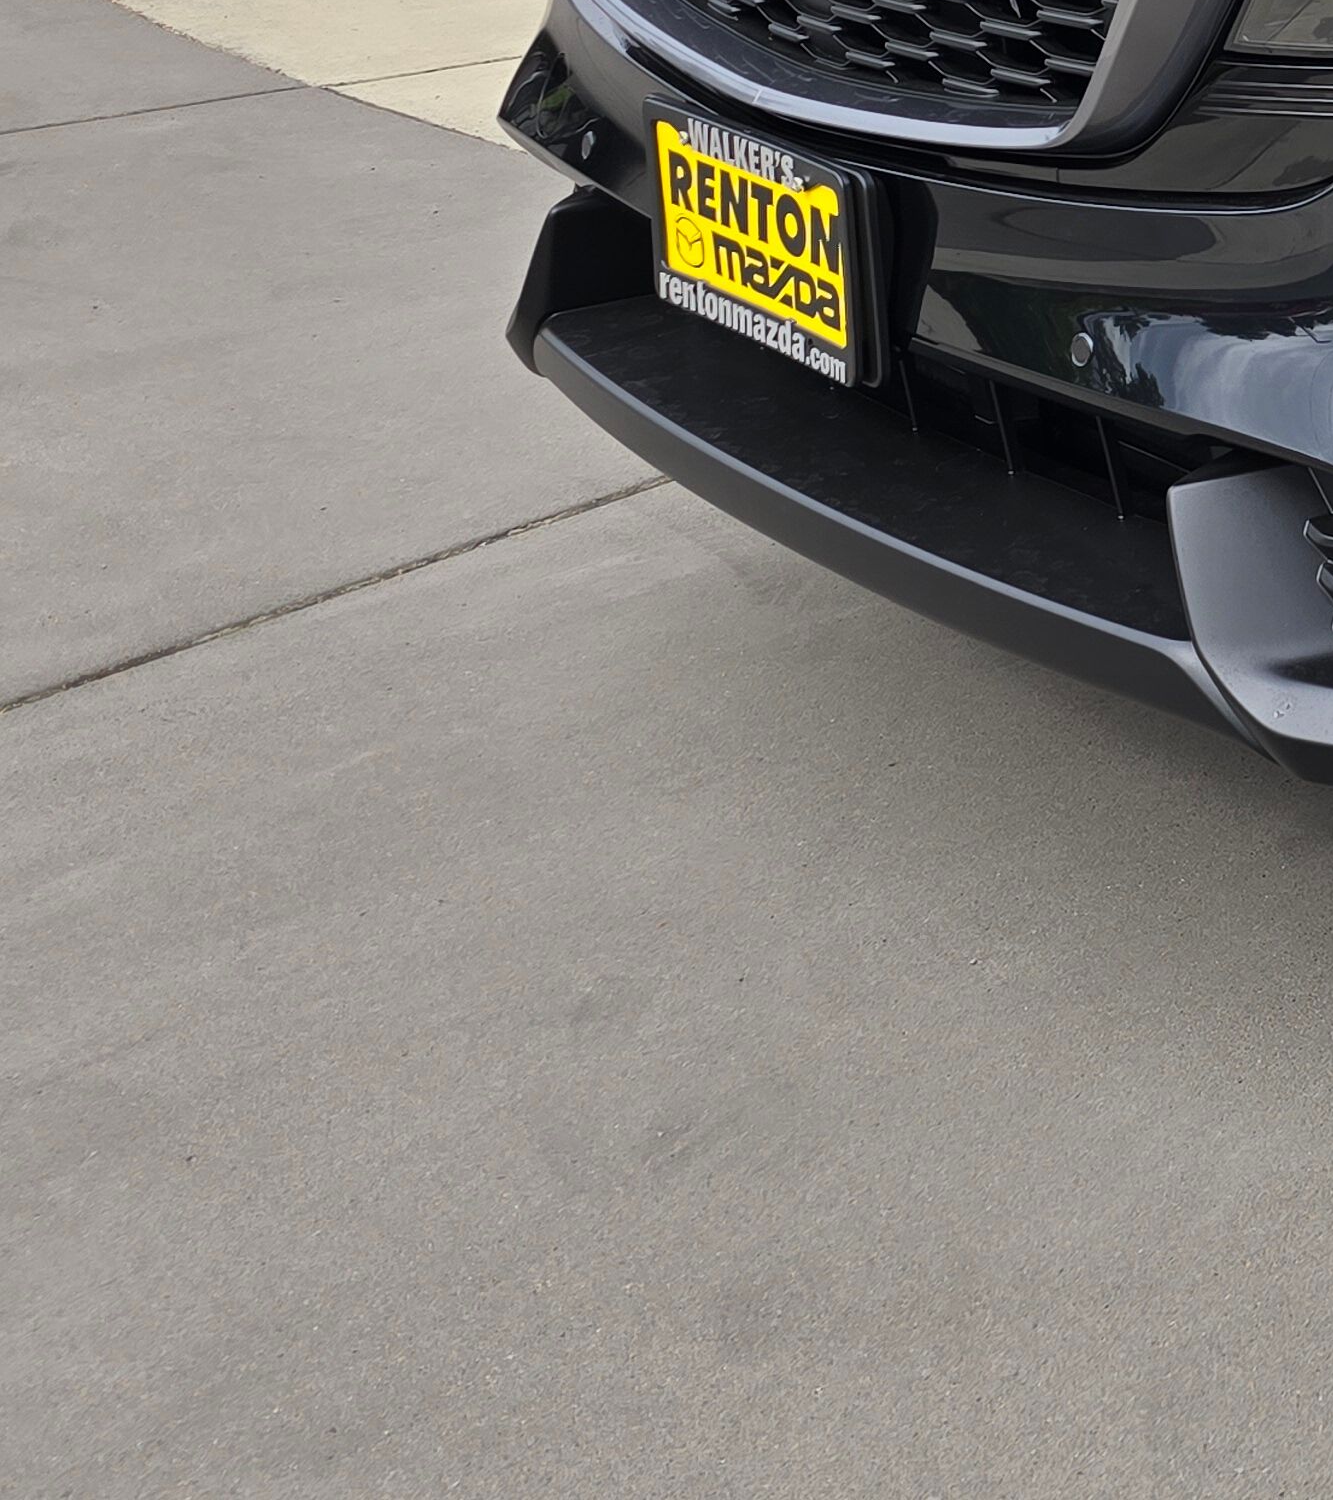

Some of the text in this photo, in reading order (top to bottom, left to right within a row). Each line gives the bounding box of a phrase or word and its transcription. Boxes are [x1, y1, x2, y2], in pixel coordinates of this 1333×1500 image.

[688, 117, 794, 186] WALKER'S
[668, 148, 840, 276] RENTON
[659, 271, 847, 384] rentonmazda.com
[712, 229, 841, 332] mazda
